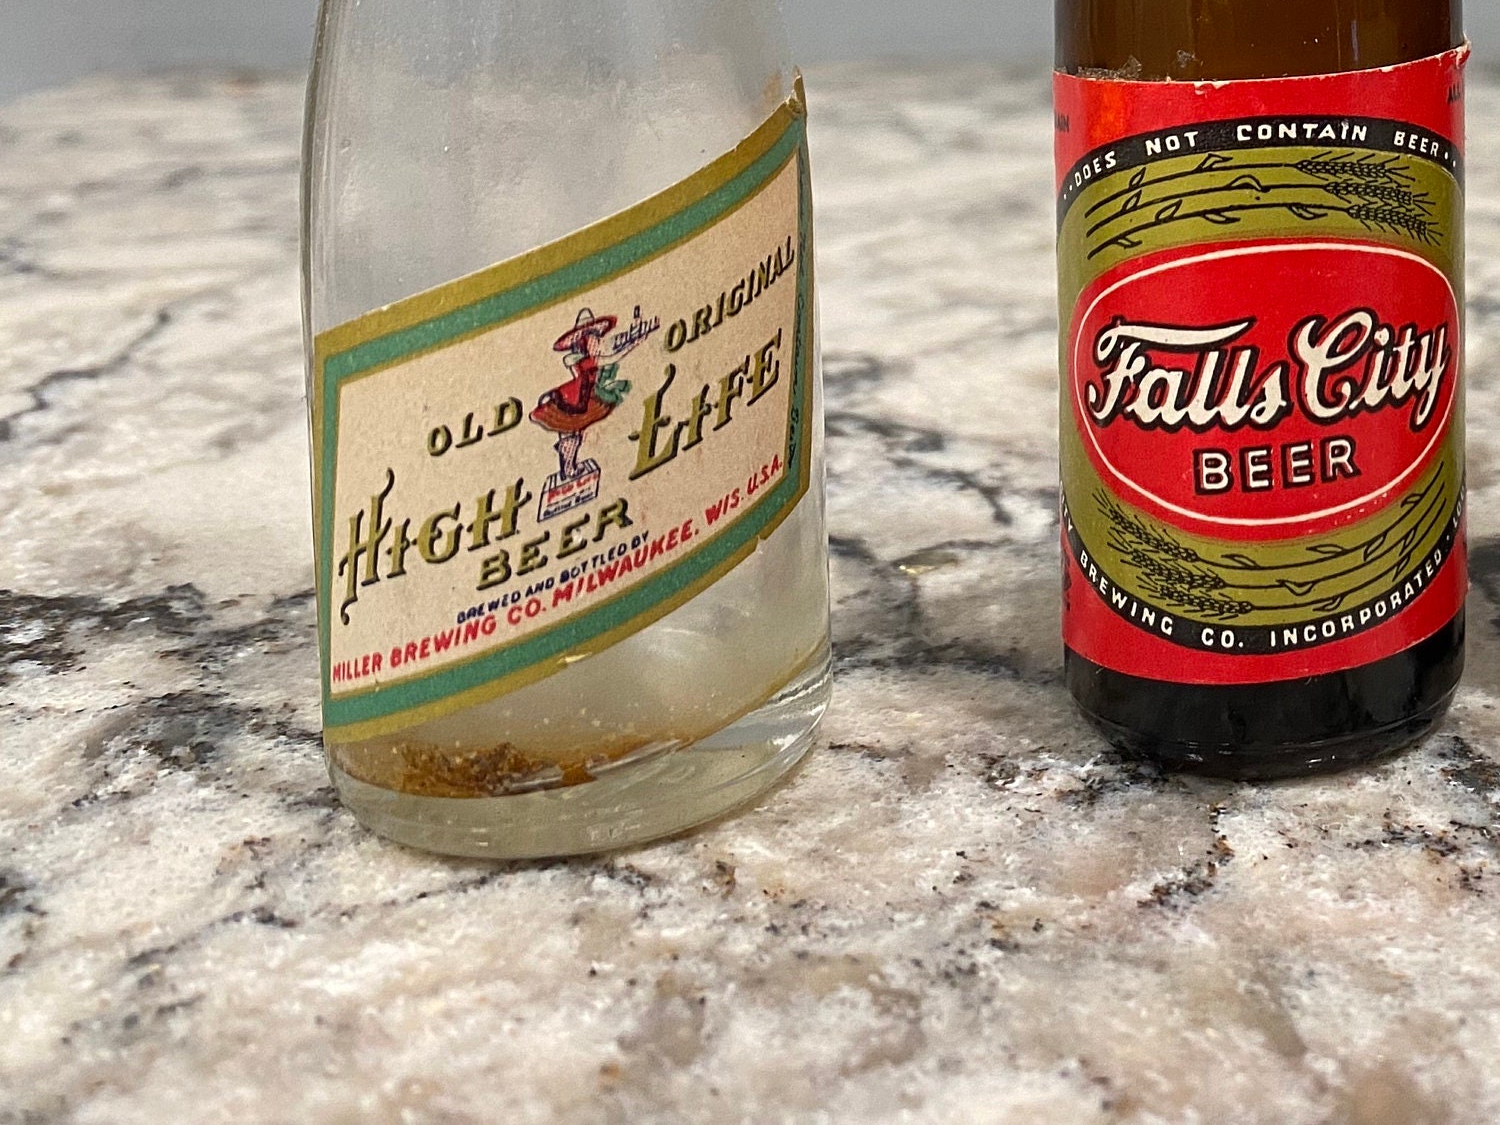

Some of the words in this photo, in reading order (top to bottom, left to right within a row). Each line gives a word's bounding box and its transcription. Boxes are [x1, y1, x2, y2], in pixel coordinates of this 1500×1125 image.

[1074, 150, 1117, 188] DOES
[1145, 130, 1199, 157] NOT
[1236, 120, 1368, 143] CONTAIN
[1393, 130, 1440, 157] BEER
[427, 396, 524, 457] OLD
[664, 235, 795, 353] ORIGINAL
[1086, 316, 1292, 432] Falls
[1288, 306, 1452, 432] City
[337, 466, 533, 626] HIGH
[628, 327, 782, 481] LIFE
[1193, 435, 1361, 495] BEER
[457, 590, 522, 625] BREWED
[525, 576, 555, 598] AND
[559, 542, 628, 584] BOTTLED
[630, 530, 650, 551] BY
[475, 497, 634, 591] BEER
[332, 652, 383, 684] MILLER
[389, 614, 497, 669] BREWING
[506, 597, 547, 625] CO.
[1080, 549, 1175, 636] BREWING
[1200, 628, 1245, 648] CO.
[1269, 548, 1442, 648] INCORPORATED
